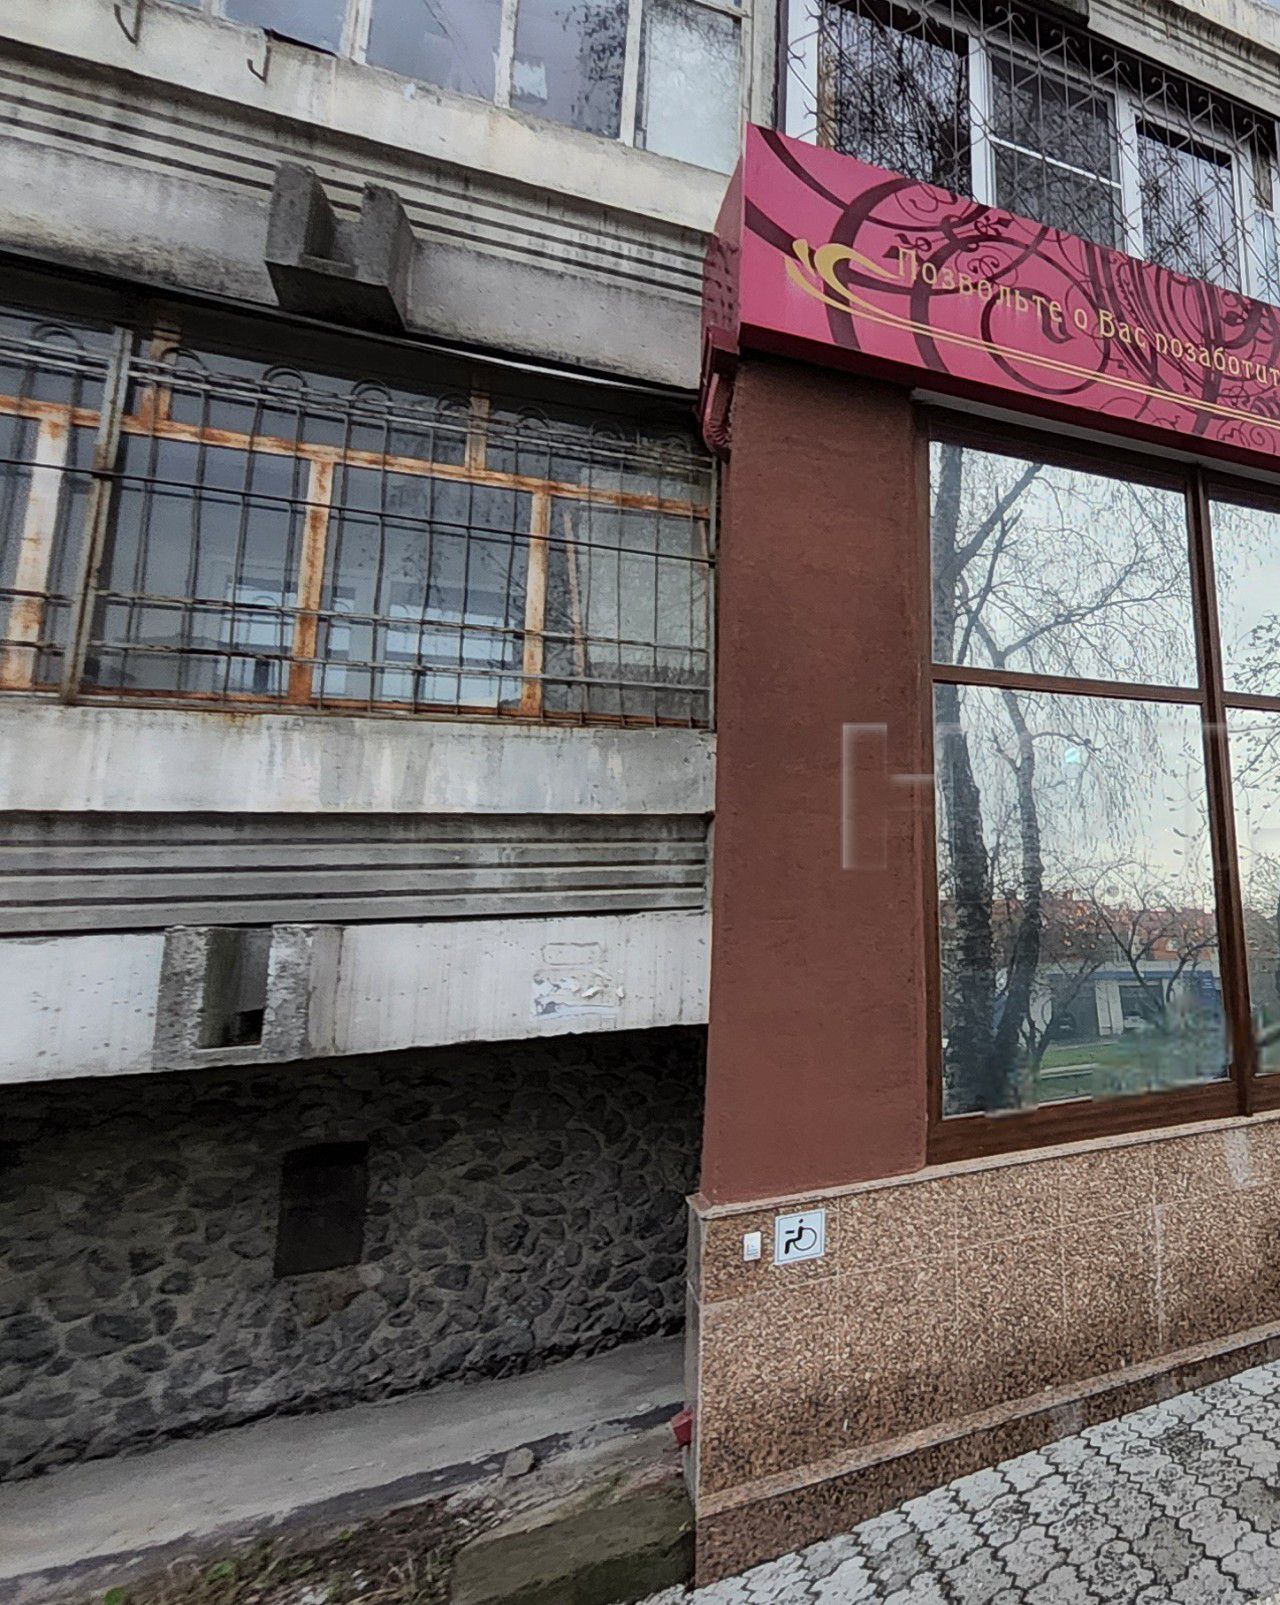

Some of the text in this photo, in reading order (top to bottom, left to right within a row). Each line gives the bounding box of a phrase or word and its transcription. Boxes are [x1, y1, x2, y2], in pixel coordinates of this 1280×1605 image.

[898, 247, 1063, 324] Позвольте
[1073, 307, 1088, 330] о
[1099, 308, 1146, 348] Вас
